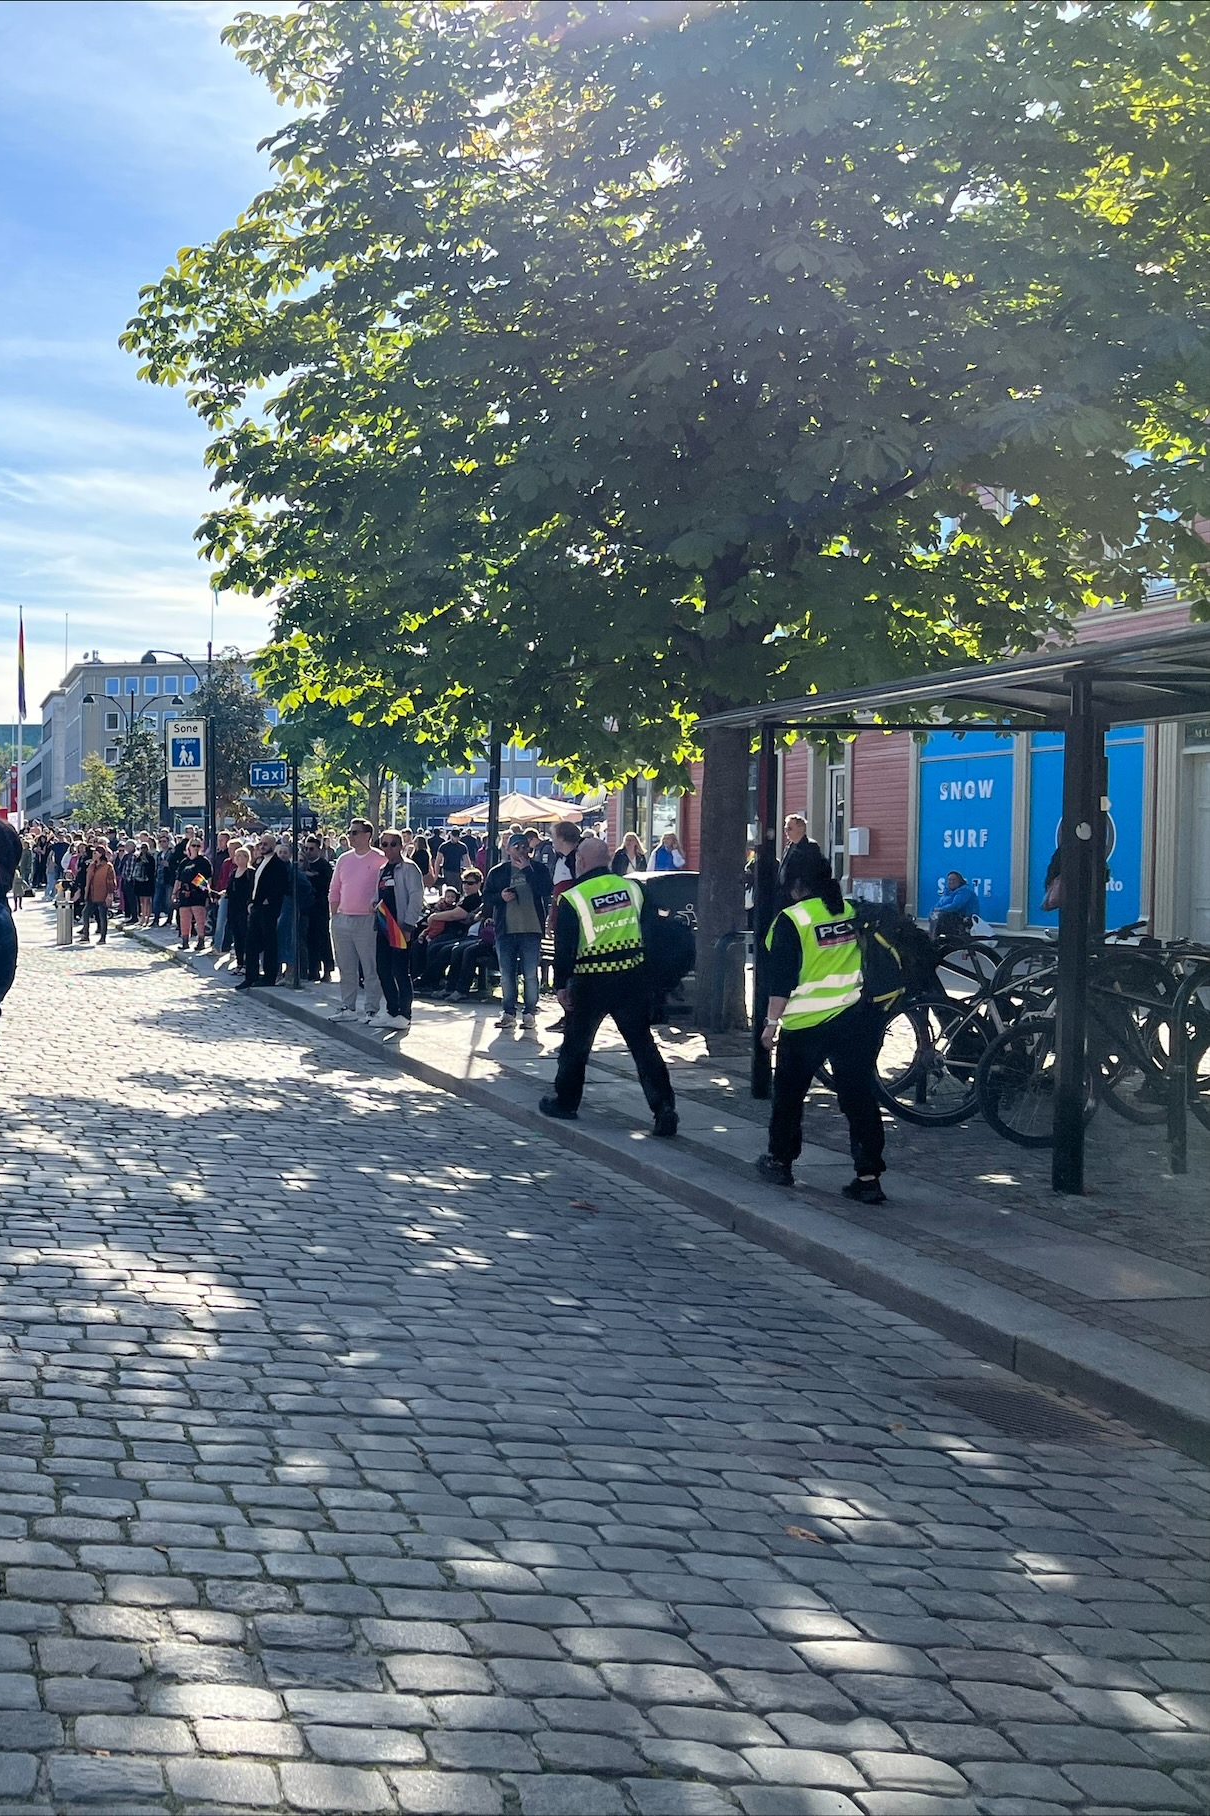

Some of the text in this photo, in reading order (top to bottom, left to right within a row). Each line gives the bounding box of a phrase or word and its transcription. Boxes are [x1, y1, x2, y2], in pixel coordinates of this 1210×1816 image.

[173, 723, 198, 734] Sone
[253, 767, 284, 781] Taxi
[939, 778, 995, 801] SNOW
[943, 828, 988, 849] SURF
[937, 877, 992, 897] STE
[593, 891, 628, 908] PCM
